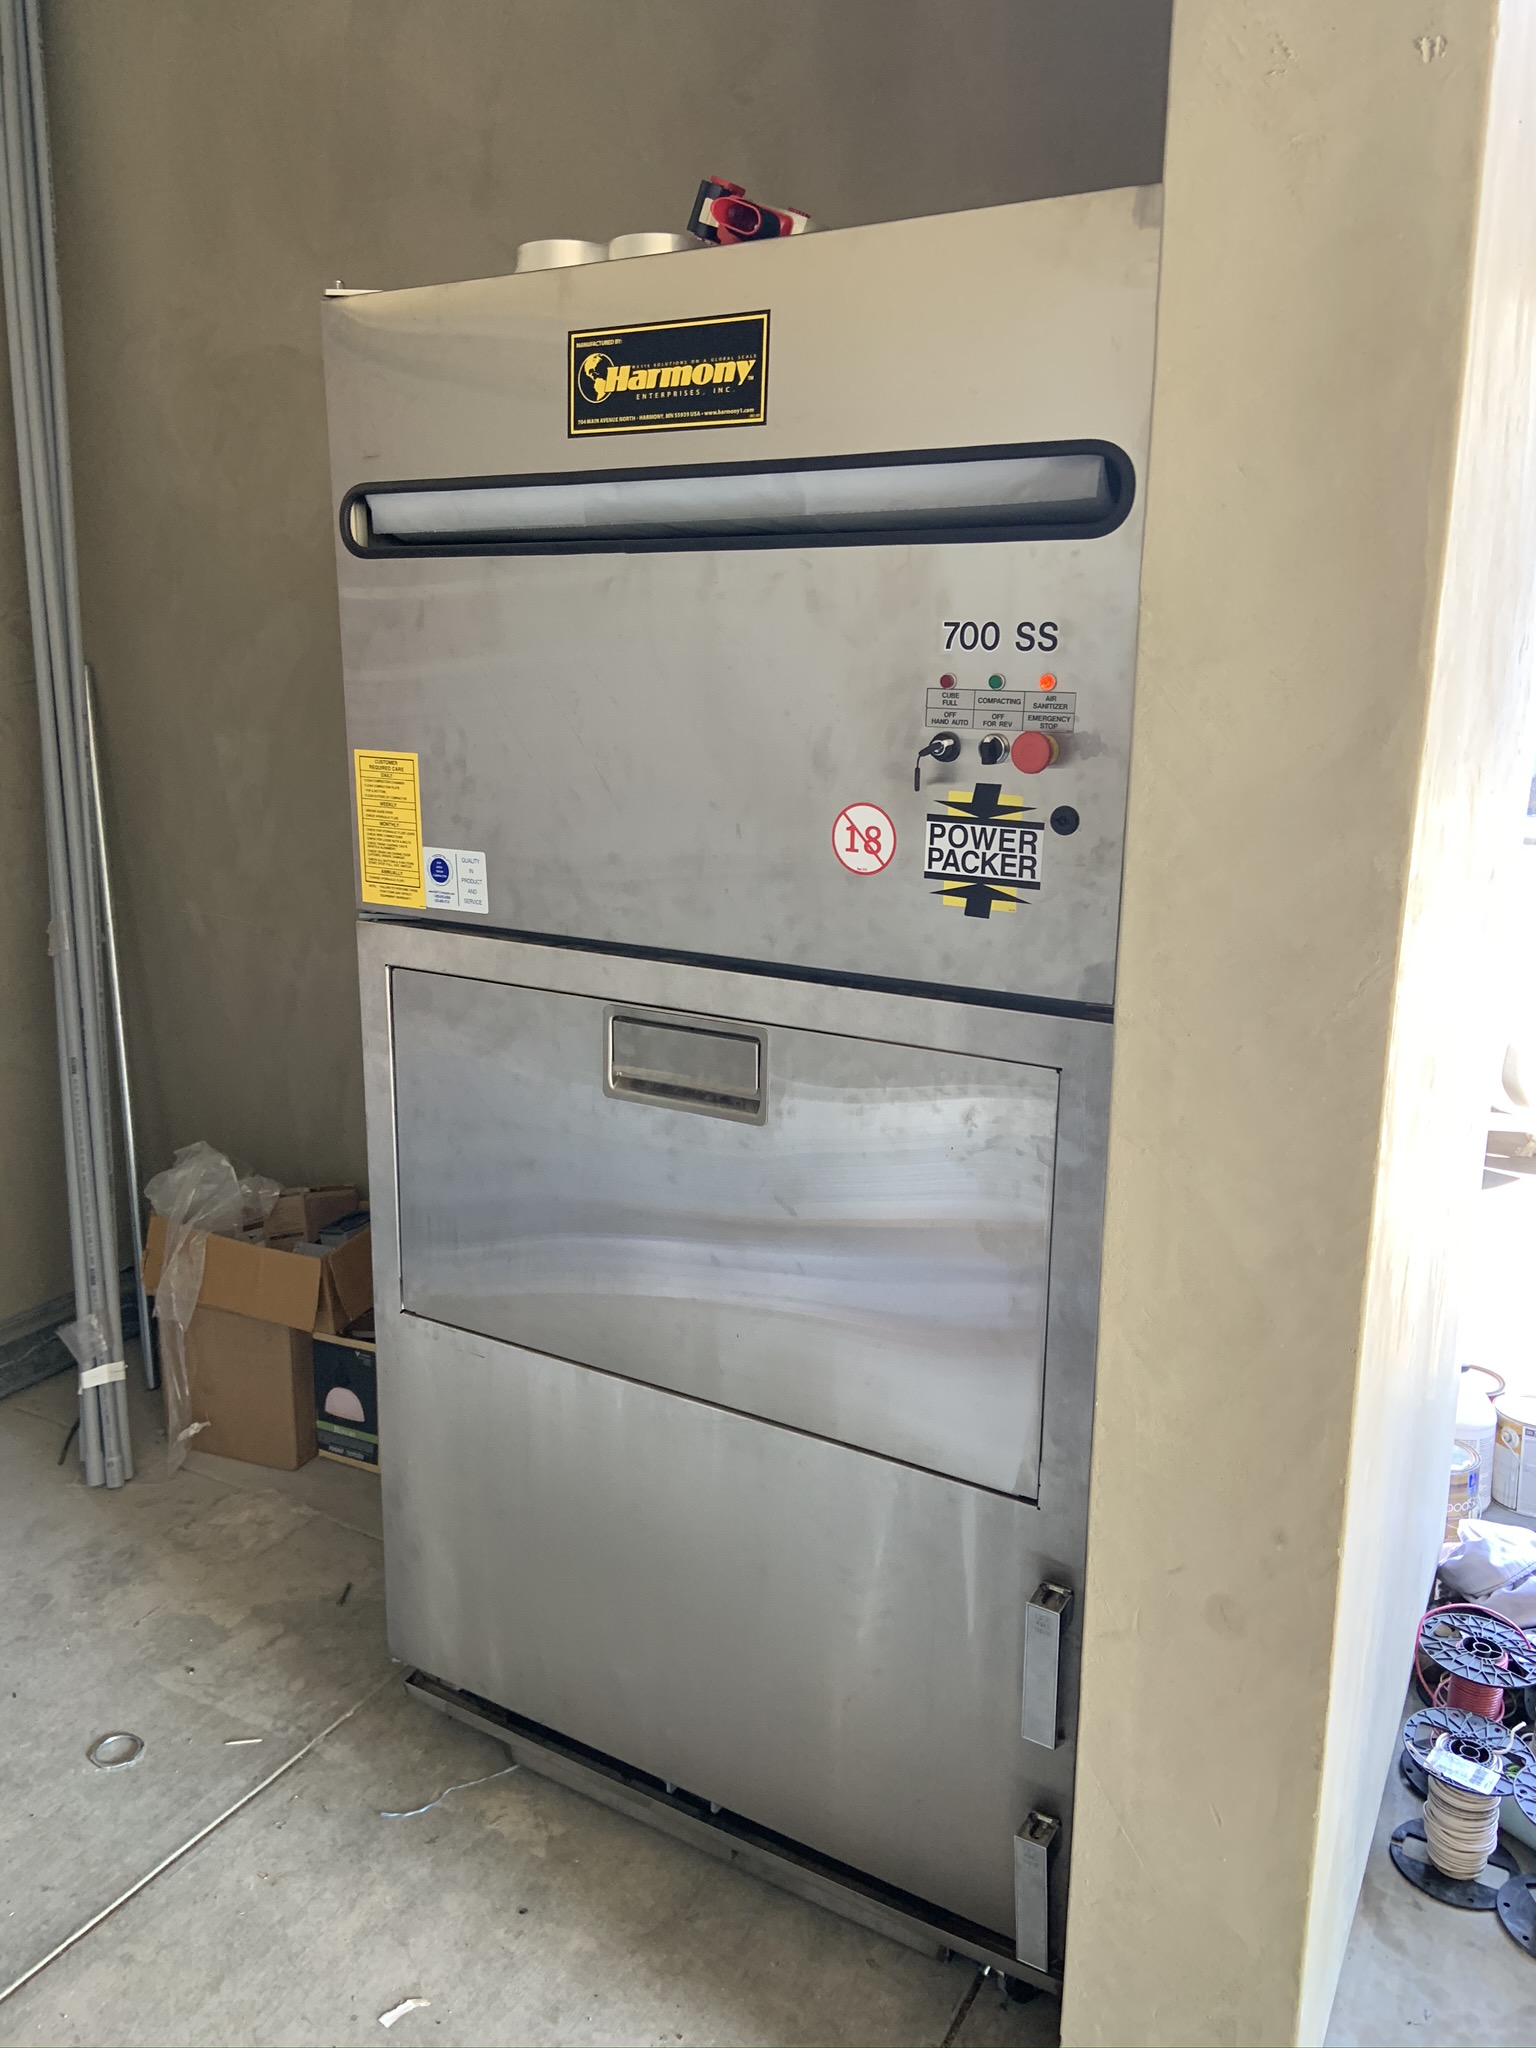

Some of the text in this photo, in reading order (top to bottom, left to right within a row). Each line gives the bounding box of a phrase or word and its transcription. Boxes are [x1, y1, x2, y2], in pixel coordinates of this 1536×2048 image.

[653, 360, 687, 368] SOLUTIONS
[604, 359, 757, 393] Harmony
[636, 386, 735, 400] ENTERPRISES, INC.
[704, 408, 754, 416] www.harmony1.com
[944, 621, 1059, 652] 700 SS
[978, 697, 1022, 705] COMPACTING
[1032, 702, 1068, 710] SANITIZER
[931, 718, 969, 726] HAND AUTO
[1028, 714, 1071, 723] EMERGENCY
[1040, 722, 1058, 730] STOP
[845, 825, 882, 855] 18
[929, 823, 1038, 855] POWER
[927, 847, 1037, 880] PACKER
[464, 898, 482, 906] SERVICE
